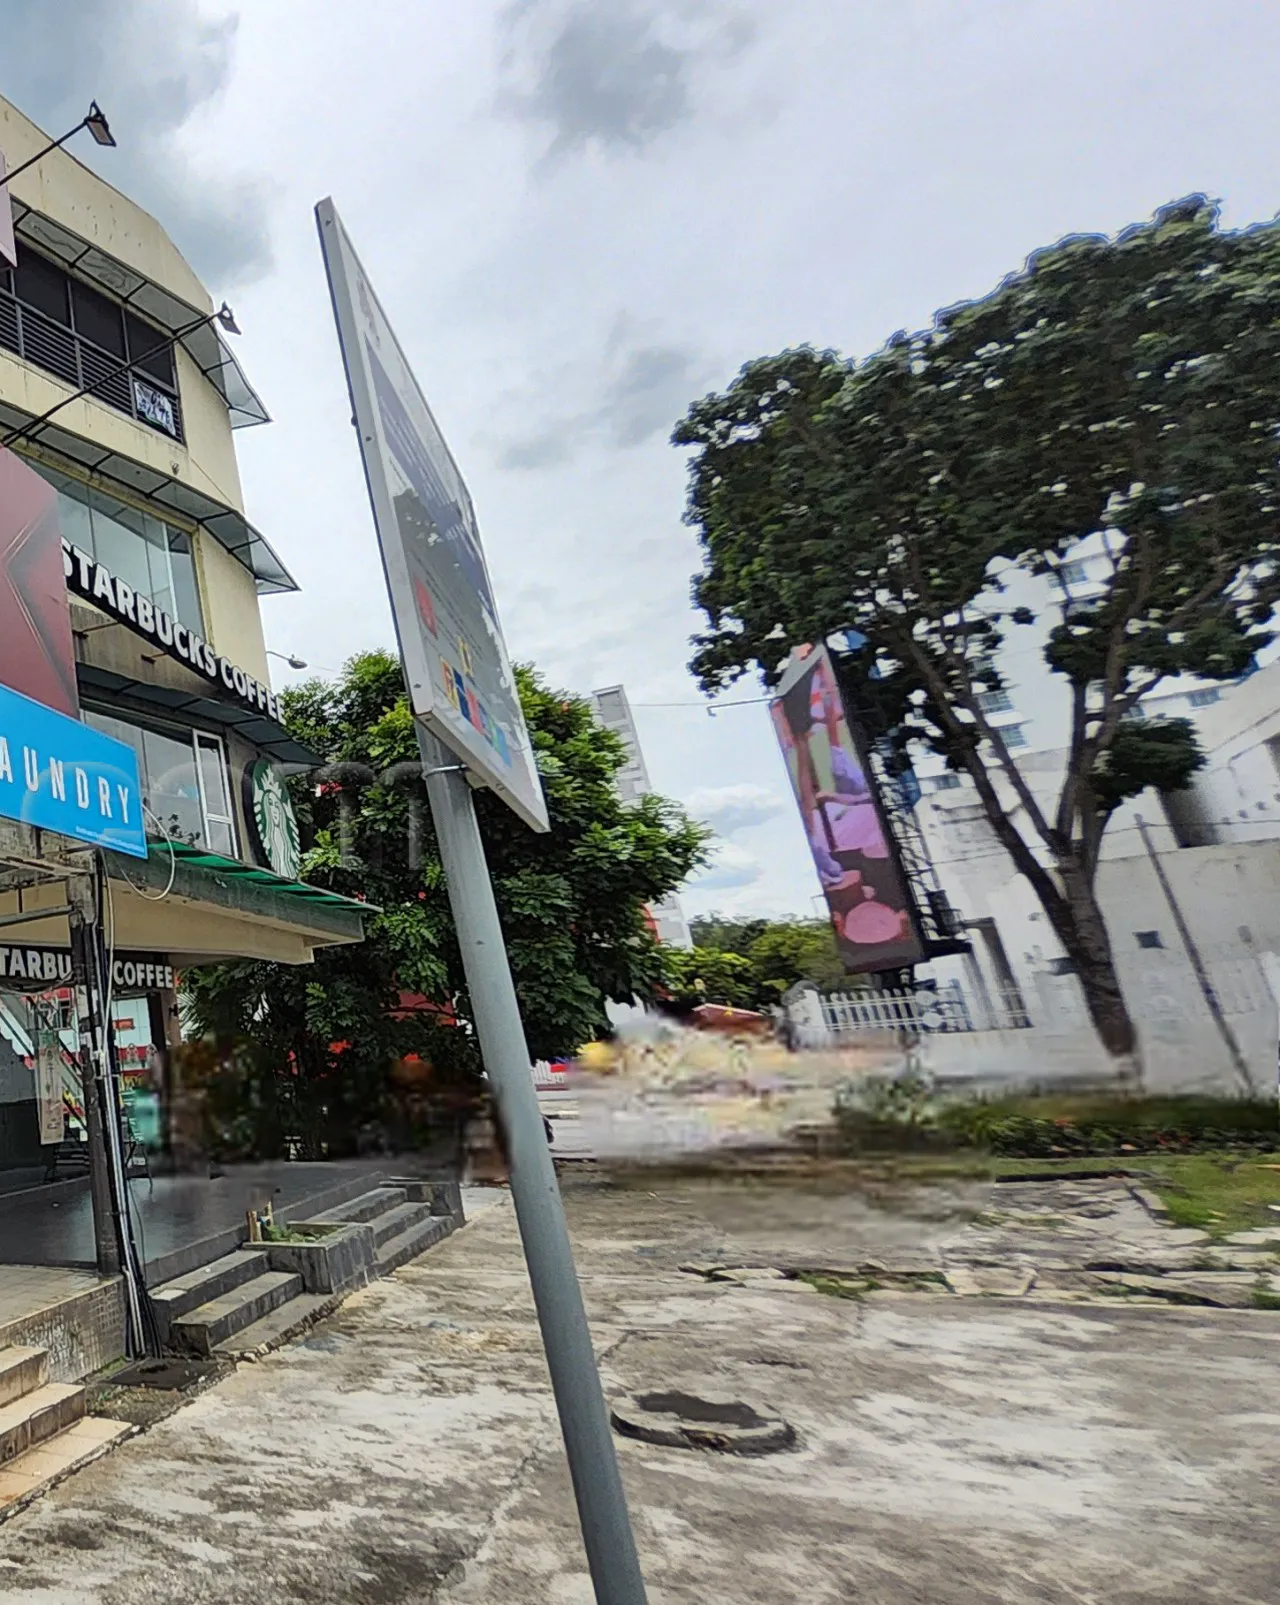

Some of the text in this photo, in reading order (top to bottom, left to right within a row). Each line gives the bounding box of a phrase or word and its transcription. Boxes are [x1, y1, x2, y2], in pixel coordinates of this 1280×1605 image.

[61, 536, 287, 726] STARBUCKS COFFEE
[113, 960, 172, 988] COFFEE
